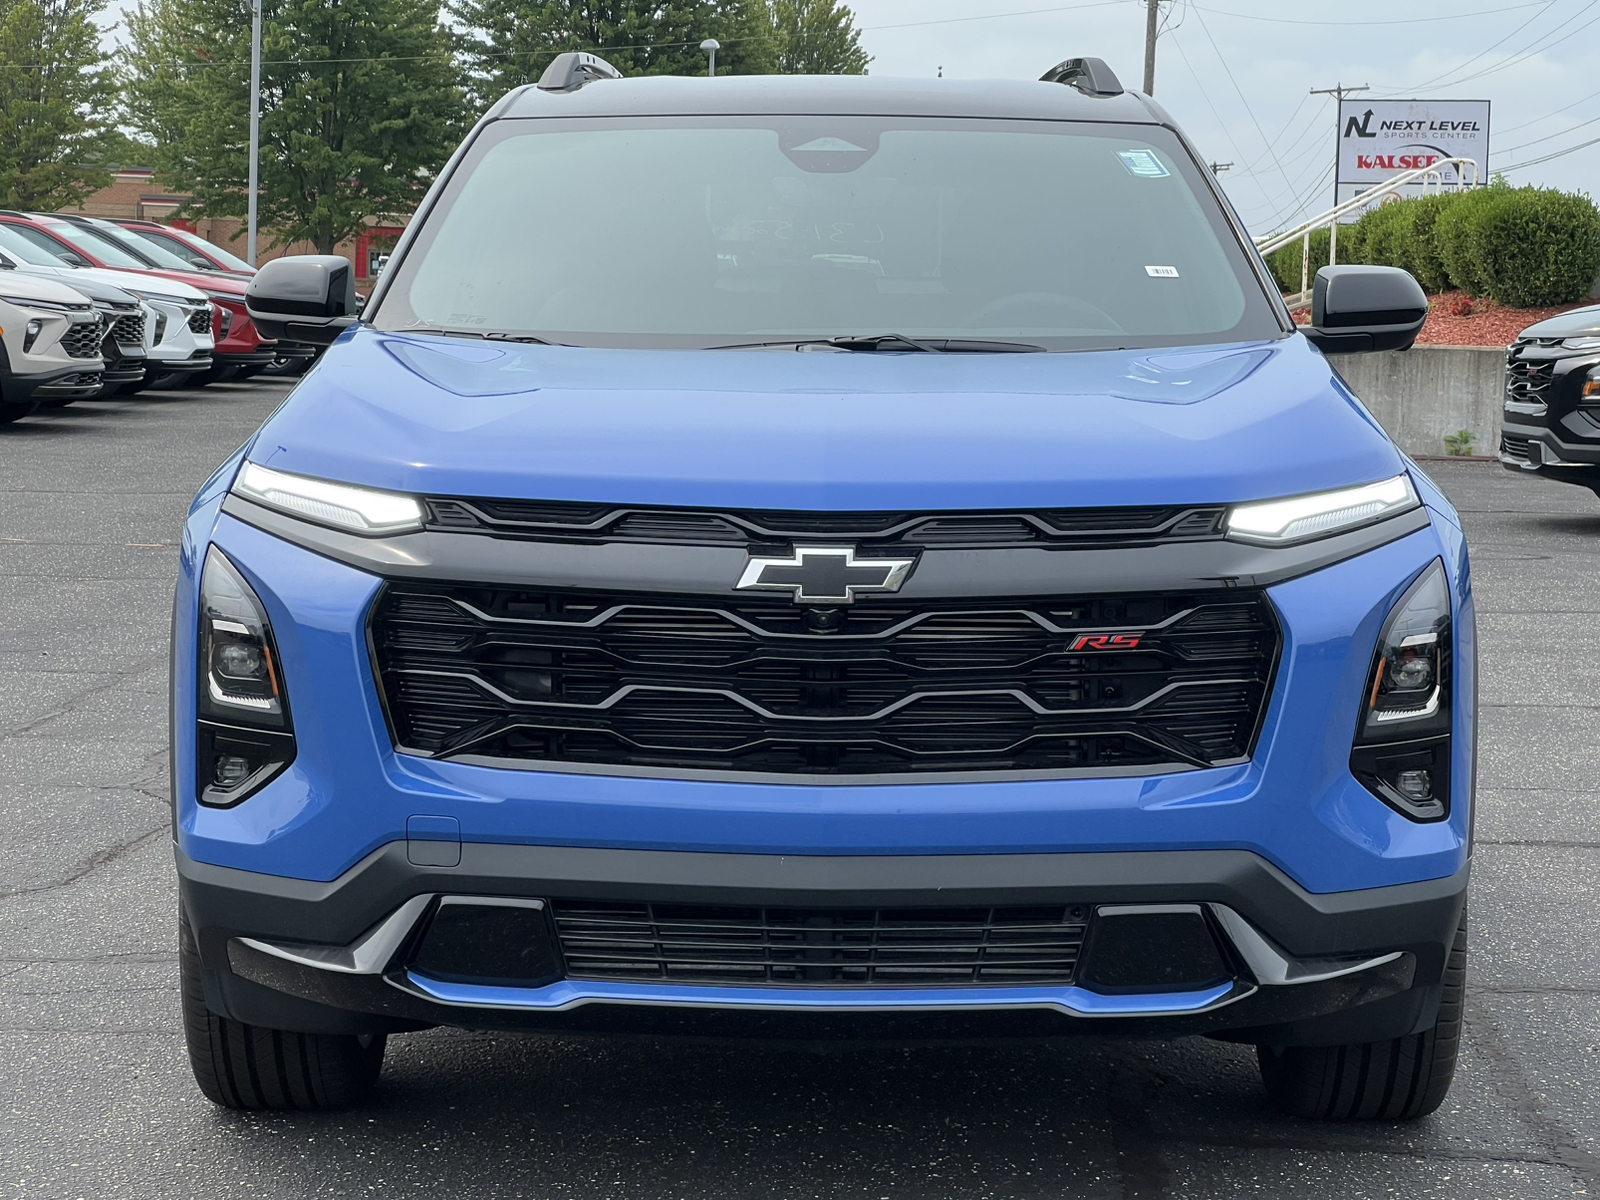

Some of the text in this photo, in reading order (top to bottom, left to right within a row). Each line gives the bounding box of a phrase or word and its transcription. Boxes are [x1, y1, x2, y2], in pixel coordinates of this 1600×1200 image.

[1380, 120, 1480, 131] NEXT LEVEL
[1432, 132, 1477, 140] CENTER
[1071, 633, 1143, 651] RS
